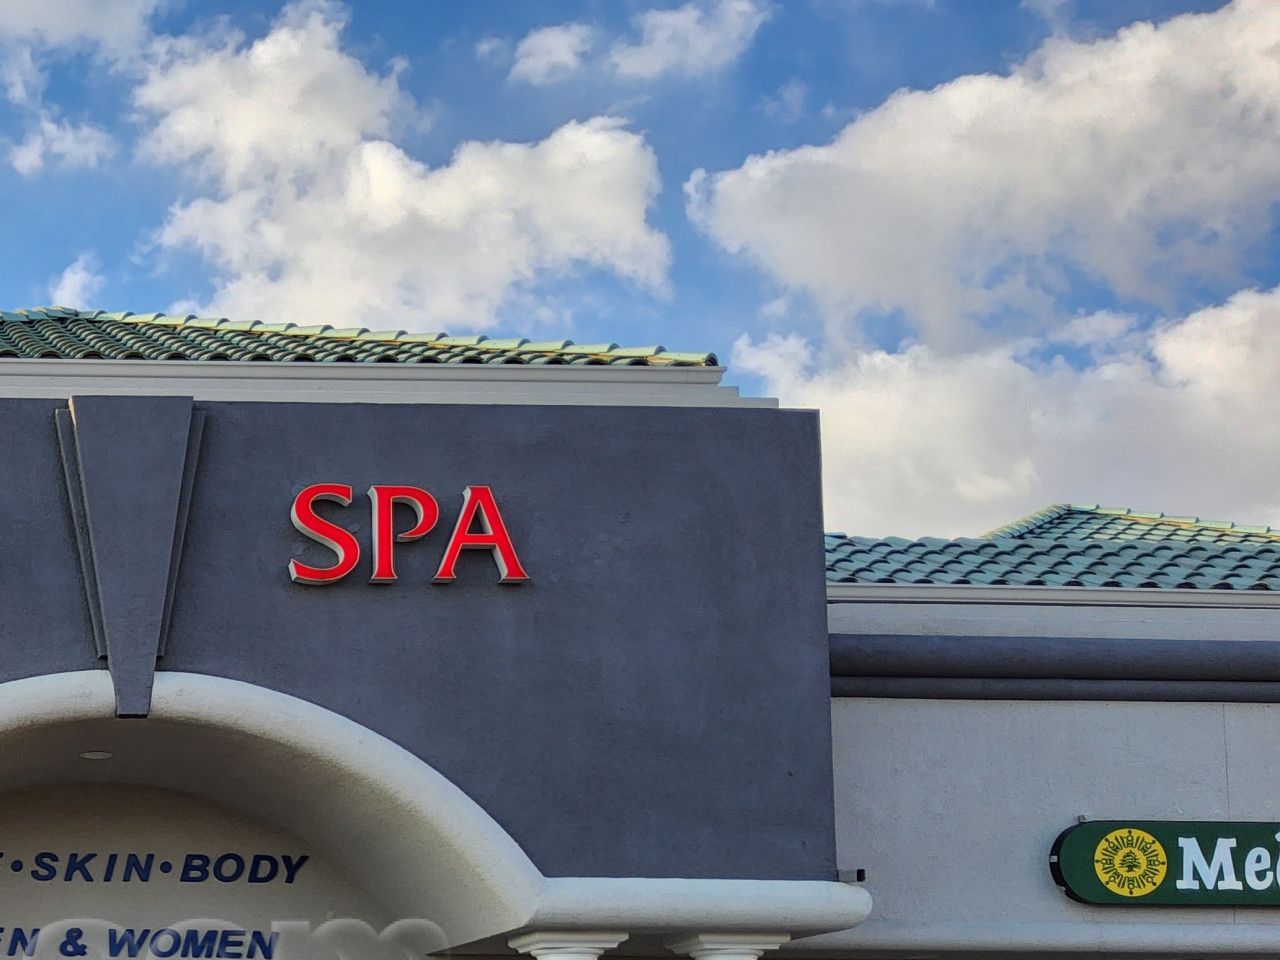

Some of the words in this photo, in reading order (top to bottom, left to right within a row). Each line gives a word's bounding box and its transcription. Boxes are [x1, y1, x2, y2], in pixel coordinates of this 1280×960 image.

[289, 483, 530, 586] SPA
[1176, 832, 1280, 890] Me
[59, 927, 88, 957] &
[107, 928, 280, 960] WOMEN
